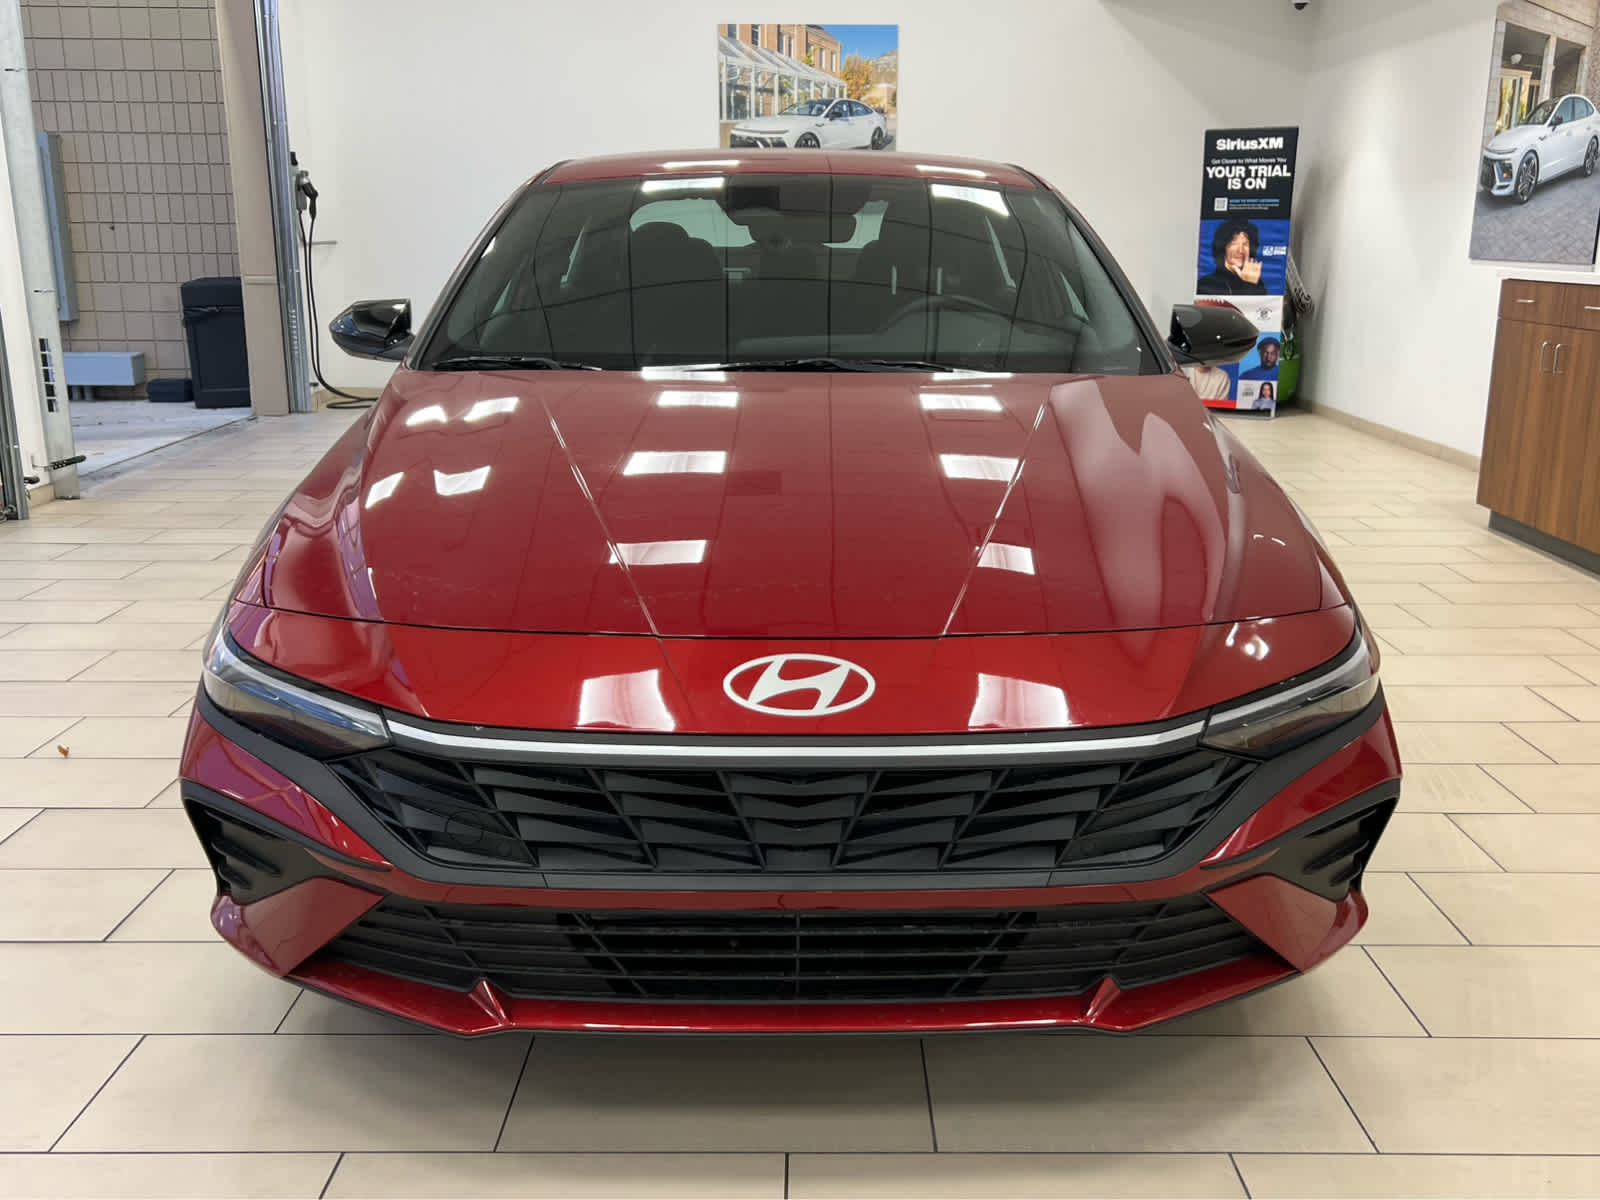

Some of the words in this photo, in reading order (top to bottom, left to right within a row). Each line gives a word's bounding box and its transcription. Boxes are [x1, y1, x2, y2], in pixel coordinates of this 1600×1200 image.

[1216, 137, 1284, 150] SiriusXM
[1206, 166, 1245, 178] YOUR
[1248, 165, 1291, 177] TRIAL
[1228, 178, 1242, 189] IS
[1244, 178, 1267, 189] ON
